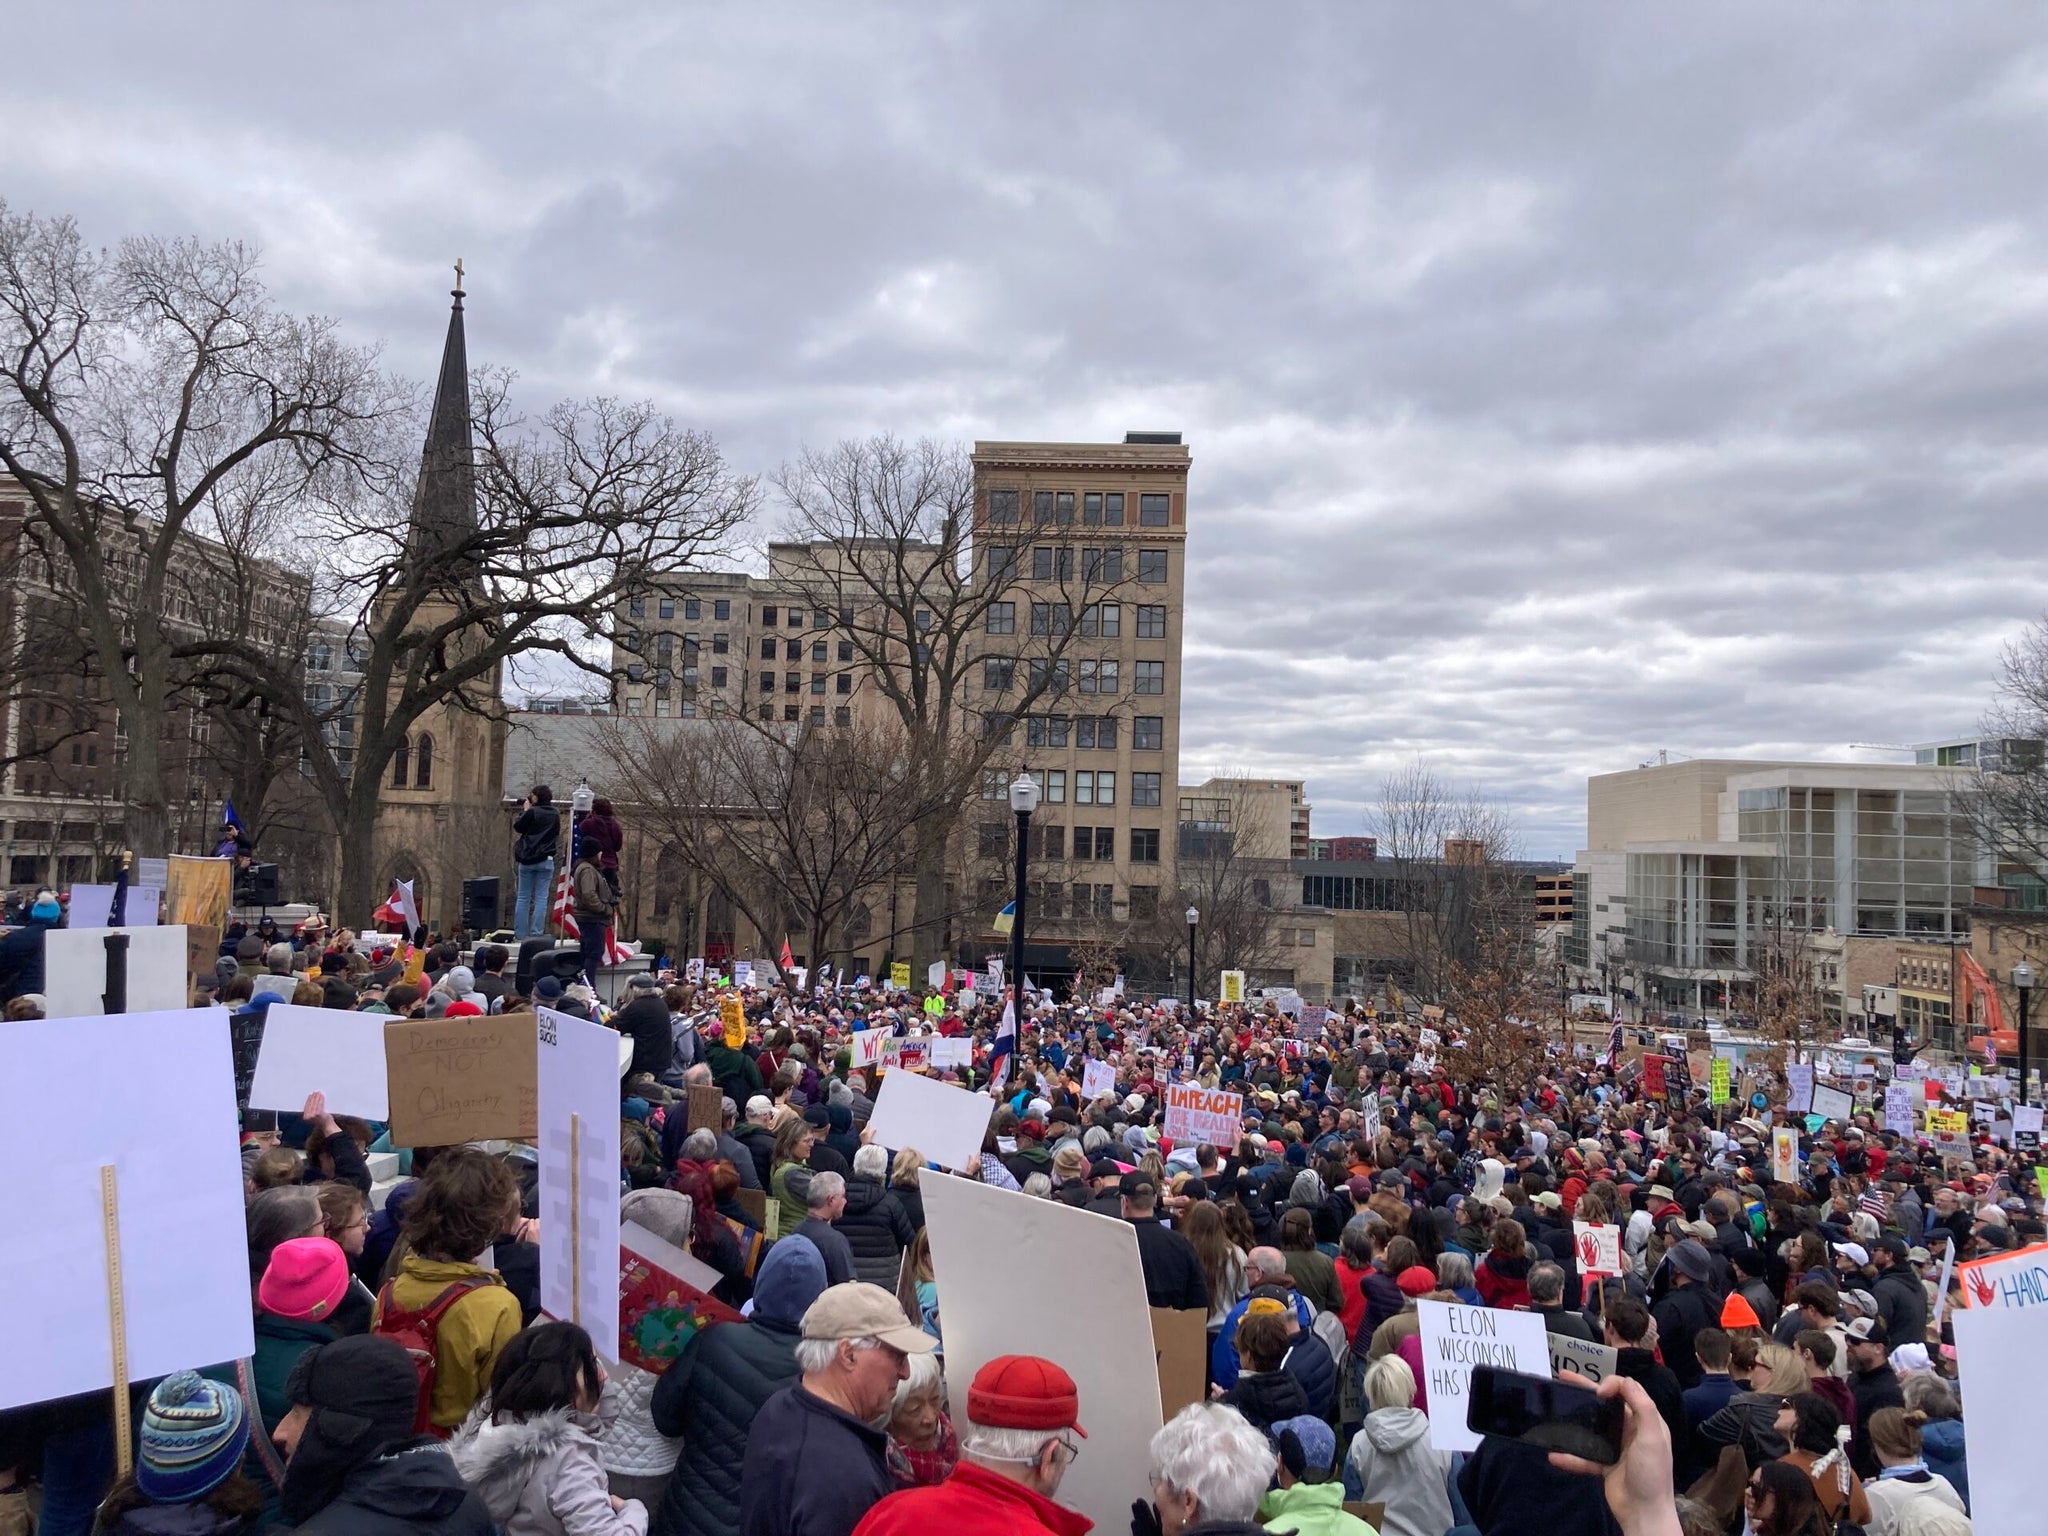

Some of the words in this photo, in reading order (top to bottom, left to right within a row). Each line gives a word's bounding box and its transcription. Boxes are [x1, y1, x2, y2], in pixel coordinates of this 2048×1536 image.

[540, 1013, 557, 1032] ELON
[540, 1029, 557, 1046] SUCKS
[435, 1051, 489, 1074] NOT
[1170, 1086, 1241, 1118] IMPEACH
[1999, 1266, 2048, 1308] HAND
[1448, 1306, 1497, 1337] ELON
[1437, 1336, 1518, 1371] WISCONSIN
[1566, 1339, 1604, 1356] choice
[1432, 1369, 1461, 1396] HAS
